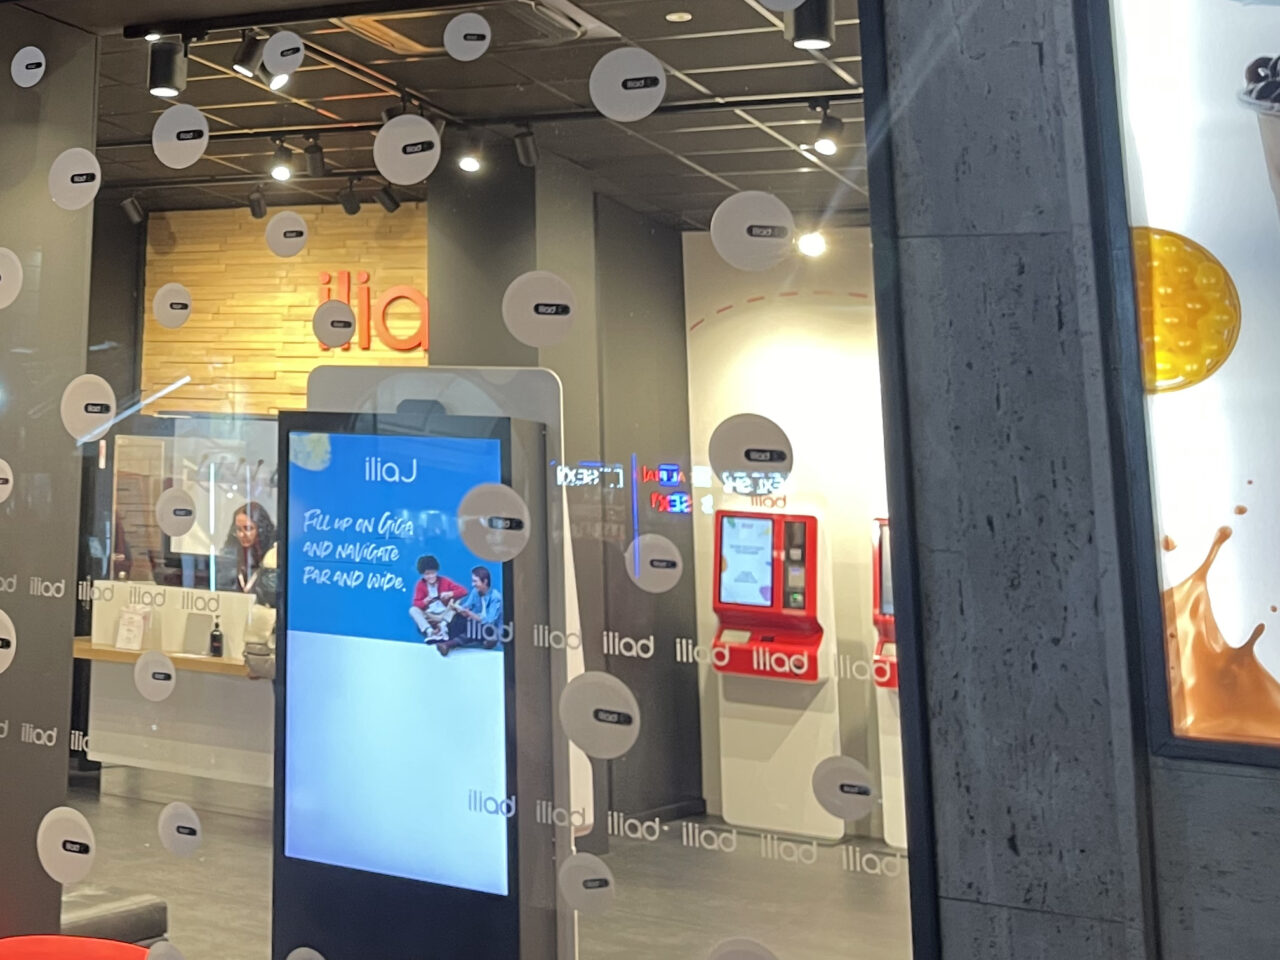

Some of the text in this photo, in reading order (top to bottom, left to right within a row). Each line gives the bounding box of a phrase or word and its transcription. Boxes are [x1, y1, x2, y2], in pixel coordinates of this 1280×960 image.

[29, 576, 66, 598] iliad
[603, 630, 655, 659] iliad
[676, 637, 731, 667] iliad
[753, 647, 809, 675] iliad
[21, 723, 57, 747] iliad
[607, 812, 660, 841] iliad
[682, 822, 737, 853] iliad
[760, 834, 819, 865] iliad
[842, 845, 902, 878] iliad
